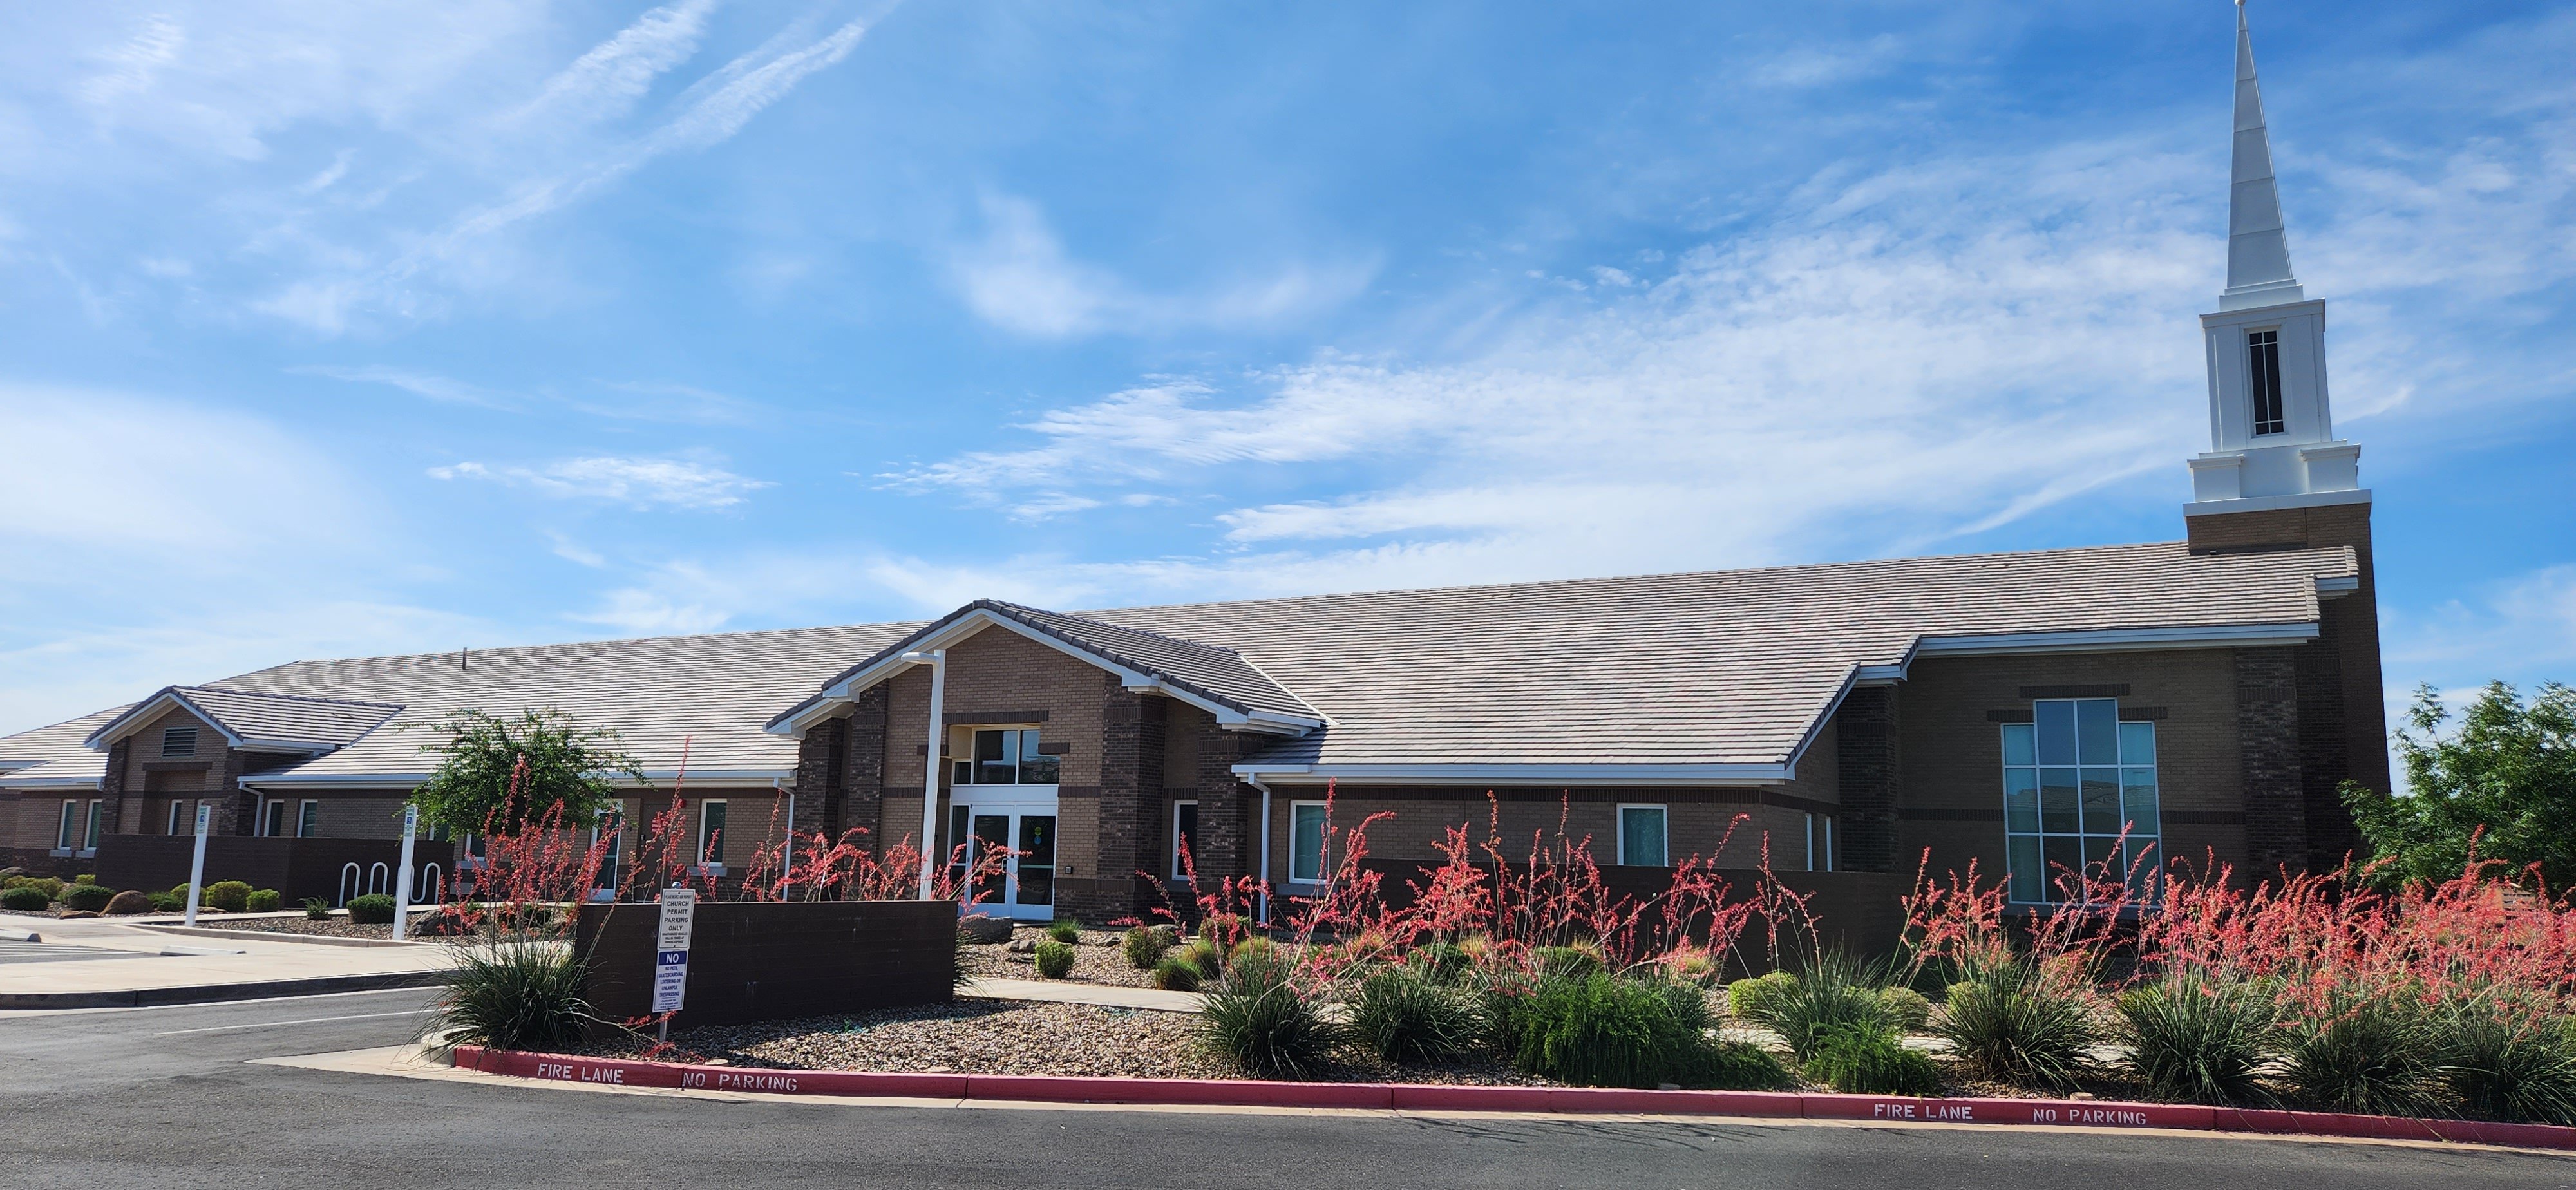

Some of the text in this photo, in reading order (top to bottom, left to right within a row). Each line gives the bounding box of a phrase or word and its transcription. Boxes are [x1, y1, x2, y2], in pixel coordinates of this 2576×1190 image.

[666, 953, 679, 963] NO
[538, 1063, 623, 1083] FIRE LANE
[682, 1072, 797, 1091] NO PARKING
[1875, 1104, 1973, 1120] FIRE LANE
[2033, 1108, 2146, 1125] NO PARKING
